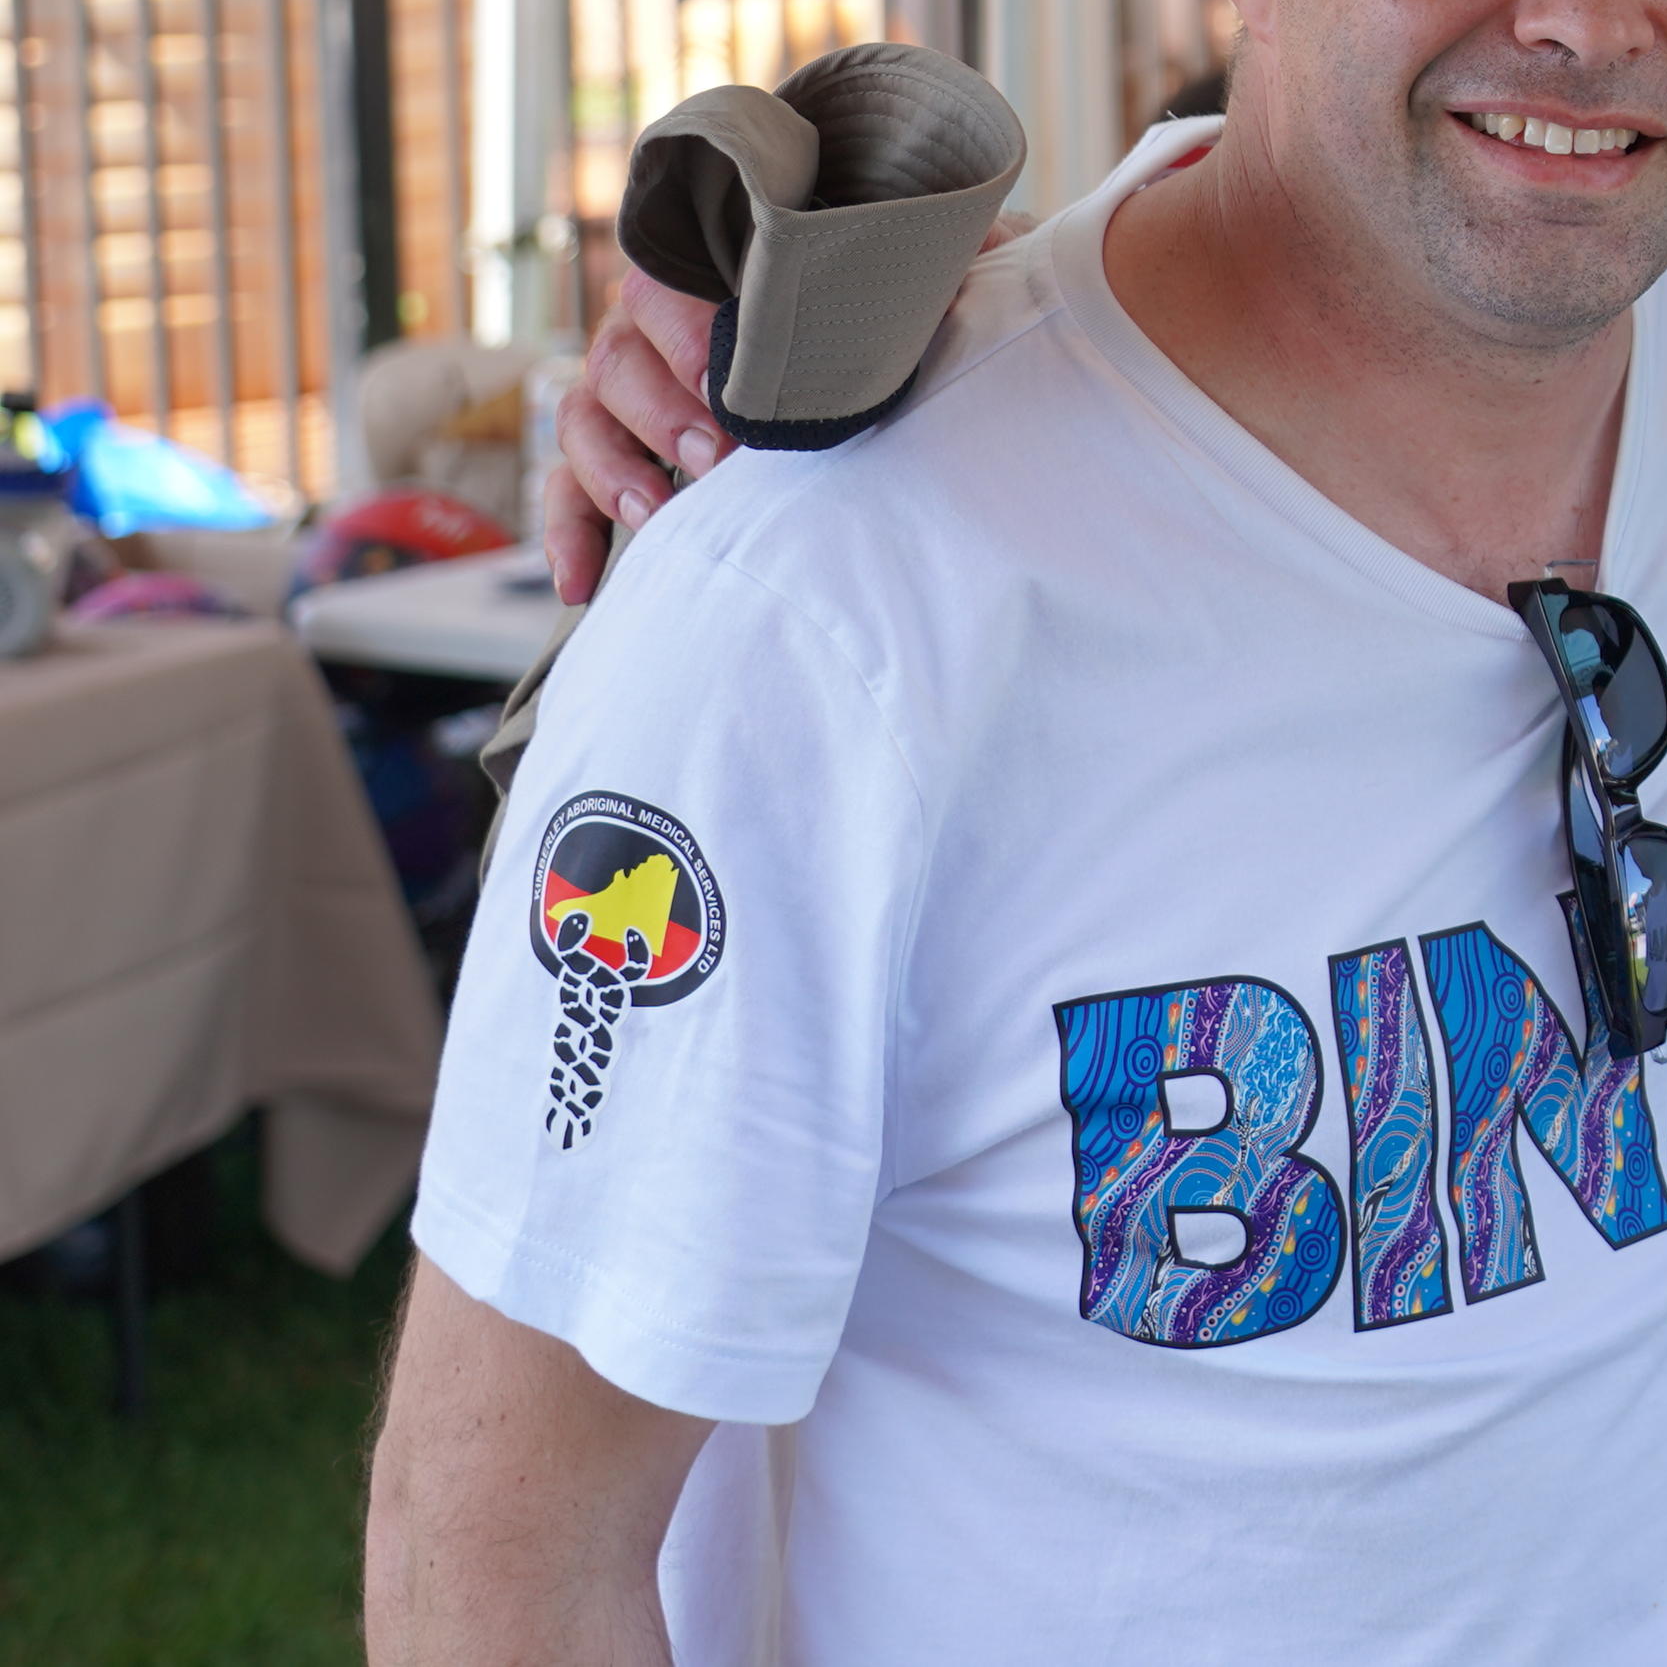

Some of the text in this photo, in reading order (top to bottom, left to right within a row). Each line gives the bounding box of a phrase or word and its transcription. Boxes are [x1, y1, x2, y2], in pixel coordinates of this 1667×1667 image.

[533, 797, 721, 974] KIMBERLEY ABORIGINAL MEDICAL SERVICES LTD
